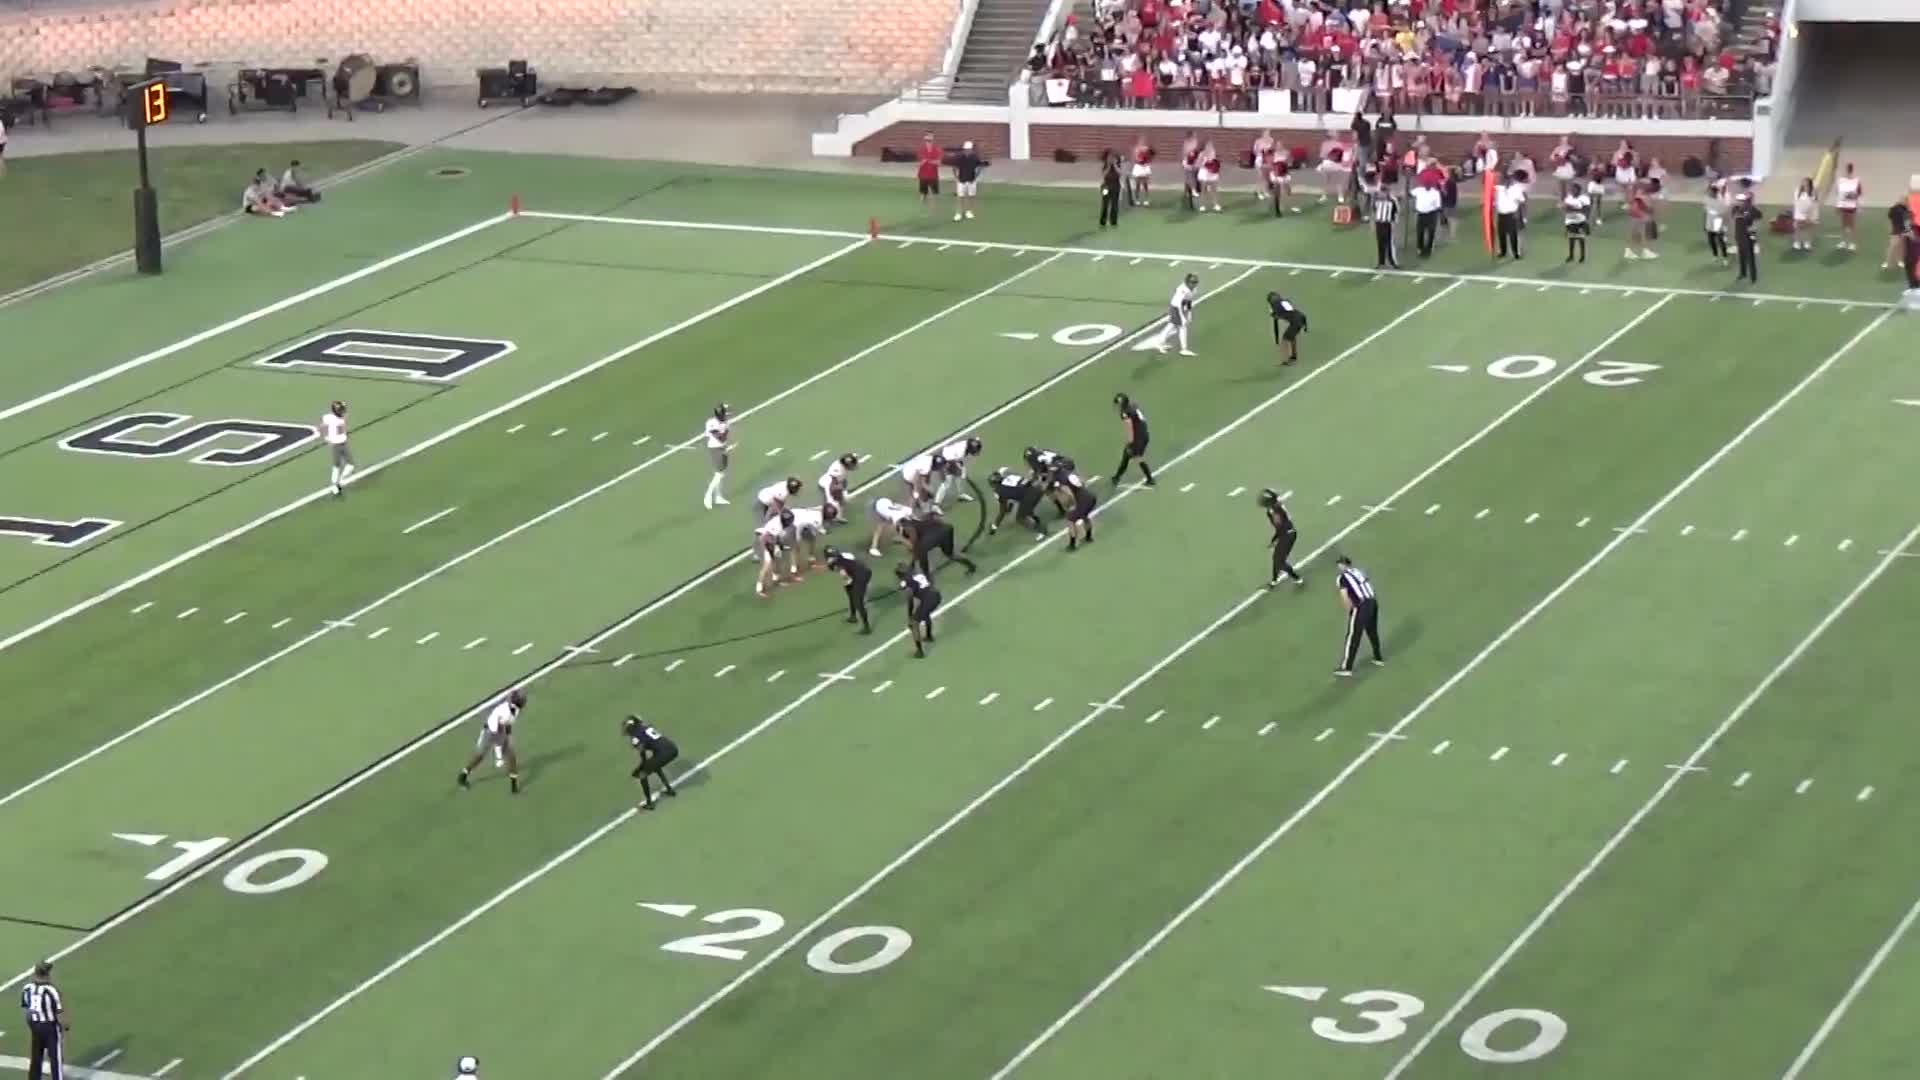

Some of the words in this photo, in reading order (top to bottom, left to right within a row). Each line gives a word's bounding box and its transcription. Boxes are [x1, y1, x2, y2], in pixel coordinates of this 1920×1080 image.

[144, 83, 166, 124] 13
[144, 837, 329, 894] 10
[659, 907, 912, 974] 20
[1311, 989, 1568, 1063] 30
